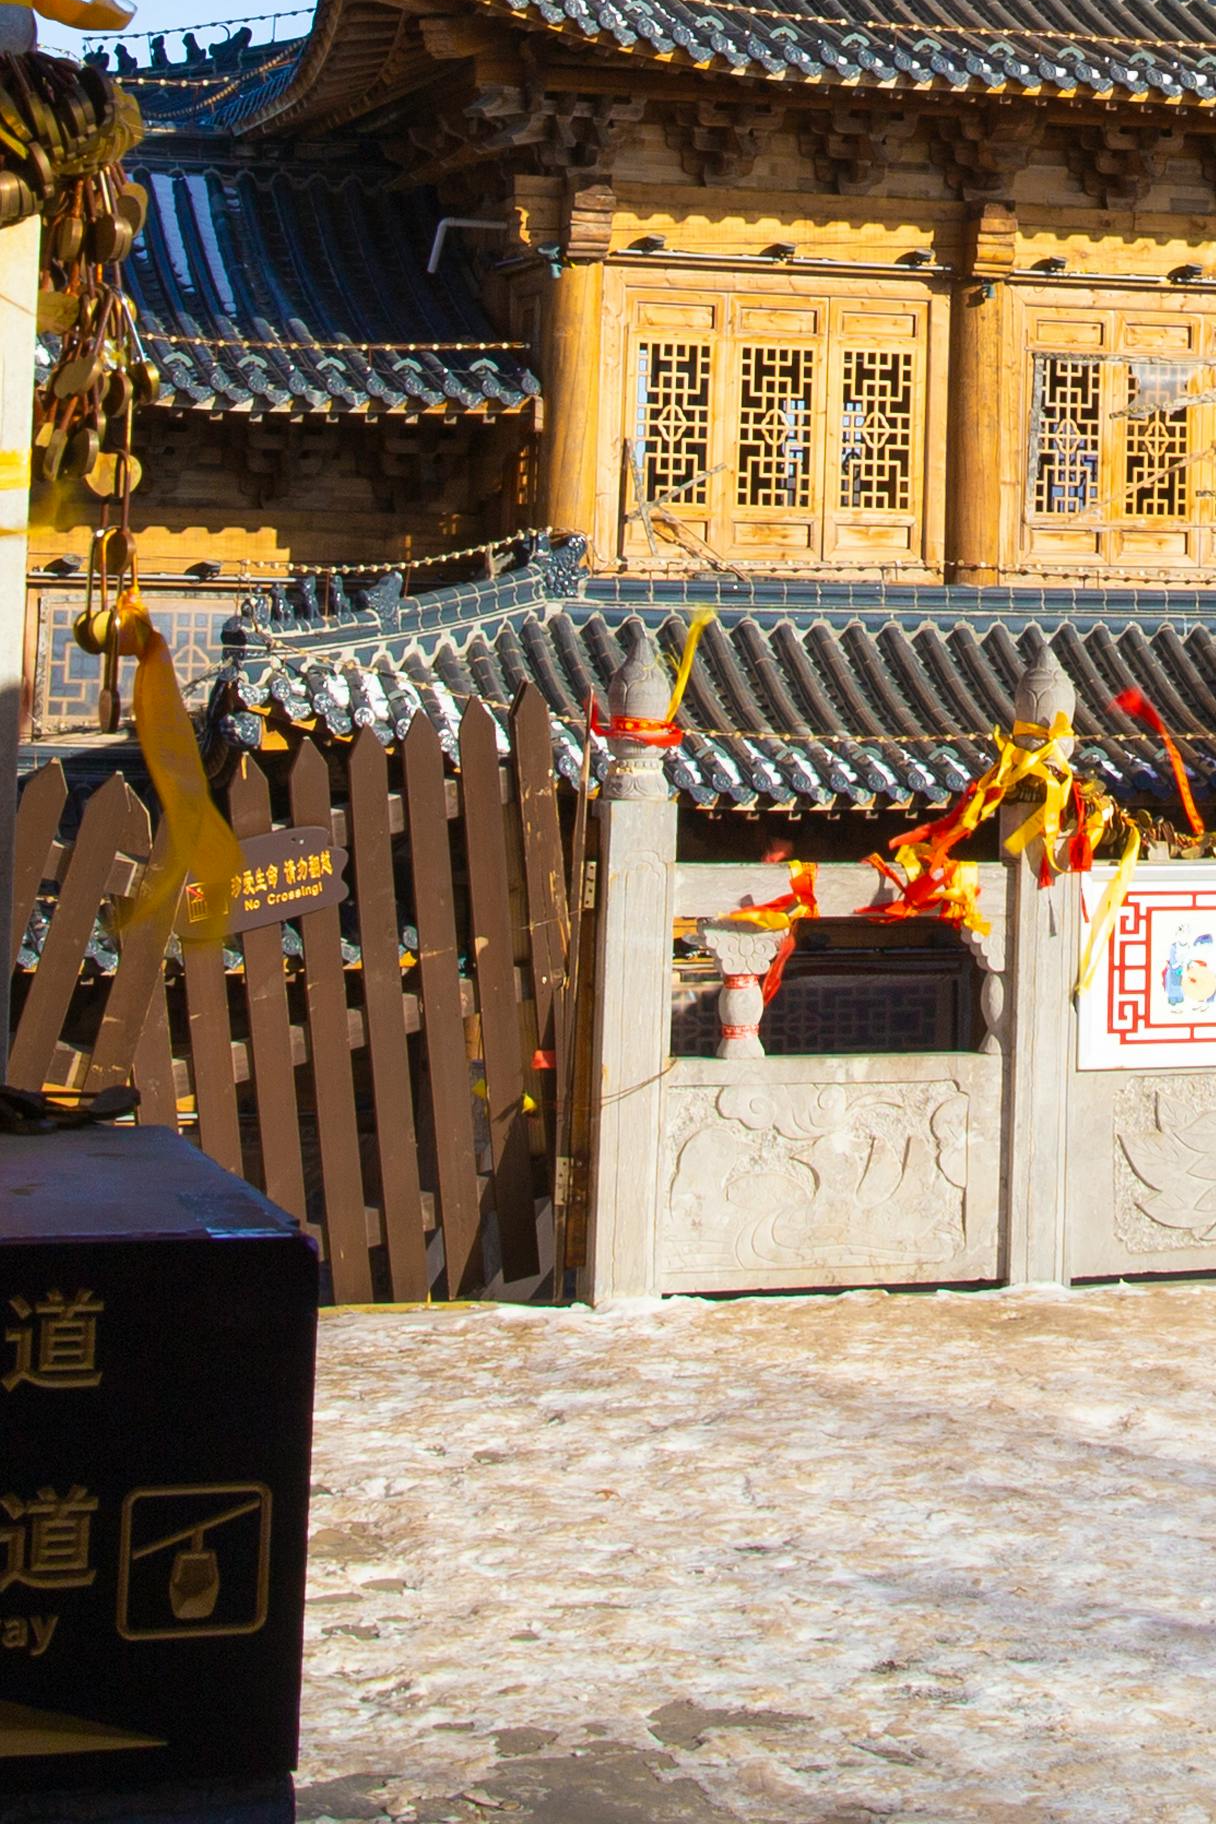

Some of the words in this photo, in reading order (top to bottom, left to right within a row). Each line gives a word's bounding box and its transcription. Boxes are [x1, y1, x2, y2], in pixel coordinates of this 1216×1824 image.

[284, 850, 333, 885] 请勿翻越
[244, 899, 261, 912] No
[267, 881, 323, 905] Crossing!
[1, 1288, 105, 1392] 道
[0, 1484, 98, 1592] 道
[0, 1616, 59, 1657] ay
